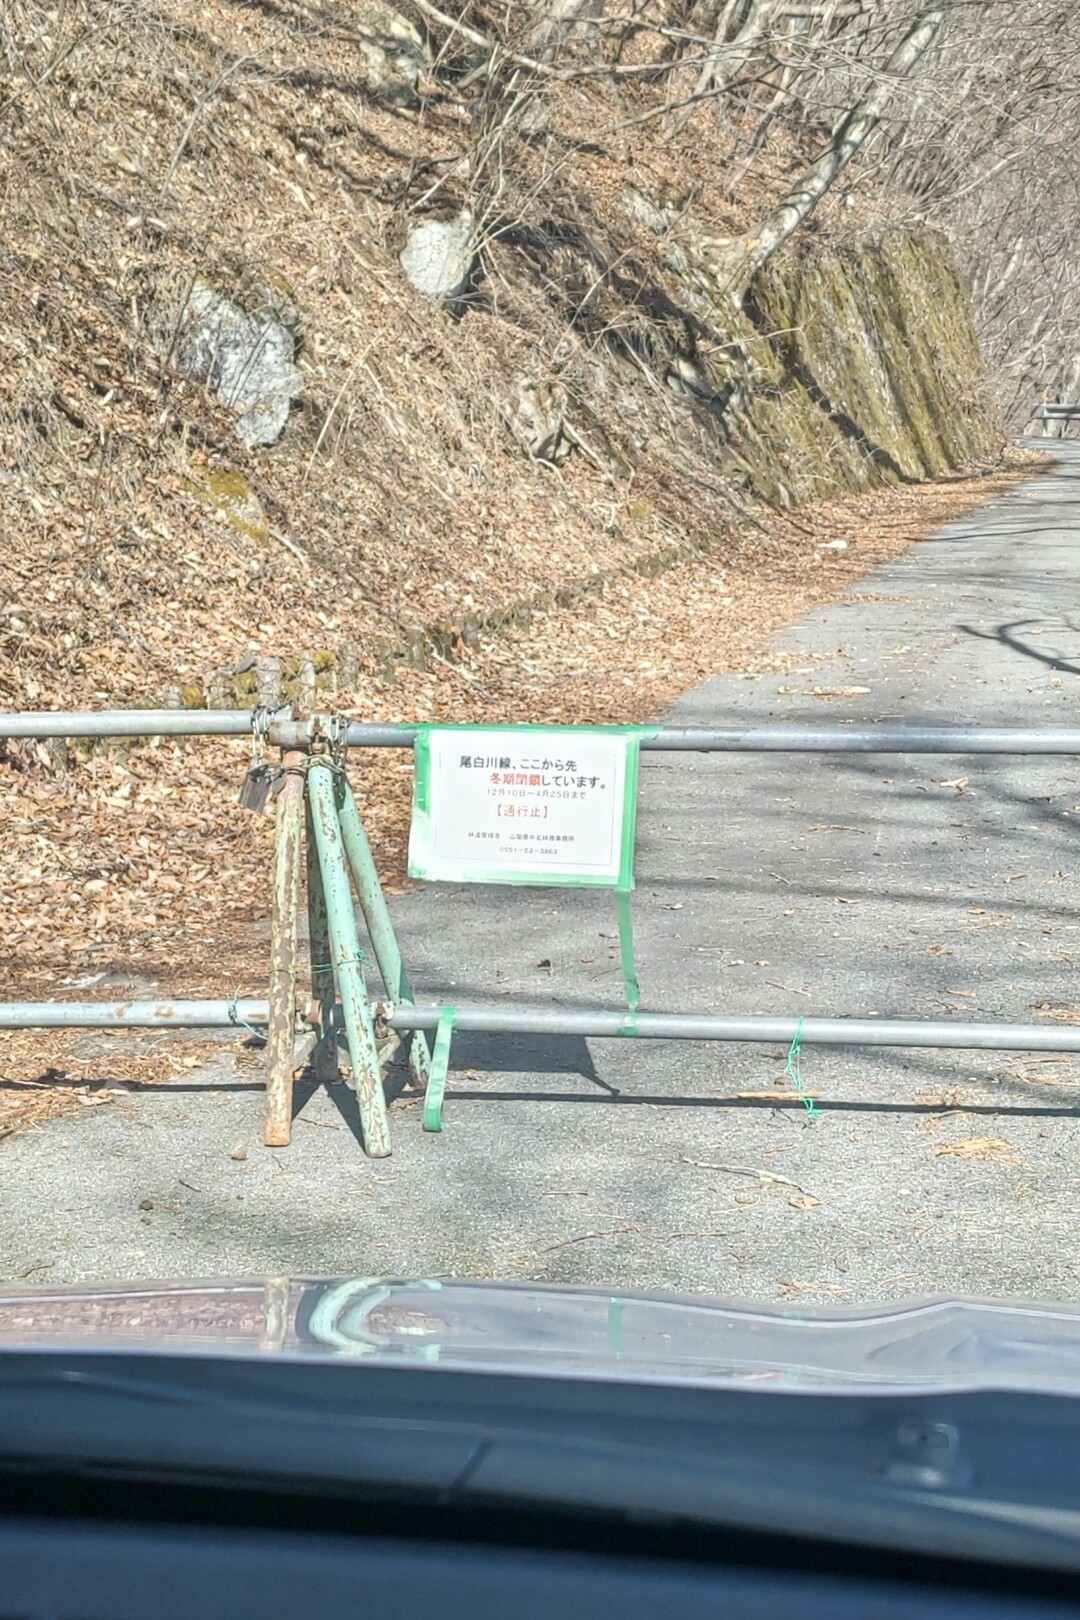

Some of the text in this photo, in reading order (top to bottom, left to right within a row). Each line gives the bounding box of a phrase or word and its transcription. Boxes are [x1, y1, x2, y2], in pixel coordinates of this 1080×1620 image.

[460, 755, 577, 771] 尾白川線、ここから先
[490, 772, 606, 789] 冬期閉鎖しています。
[497, 804, 548, 818] 【通行止】
